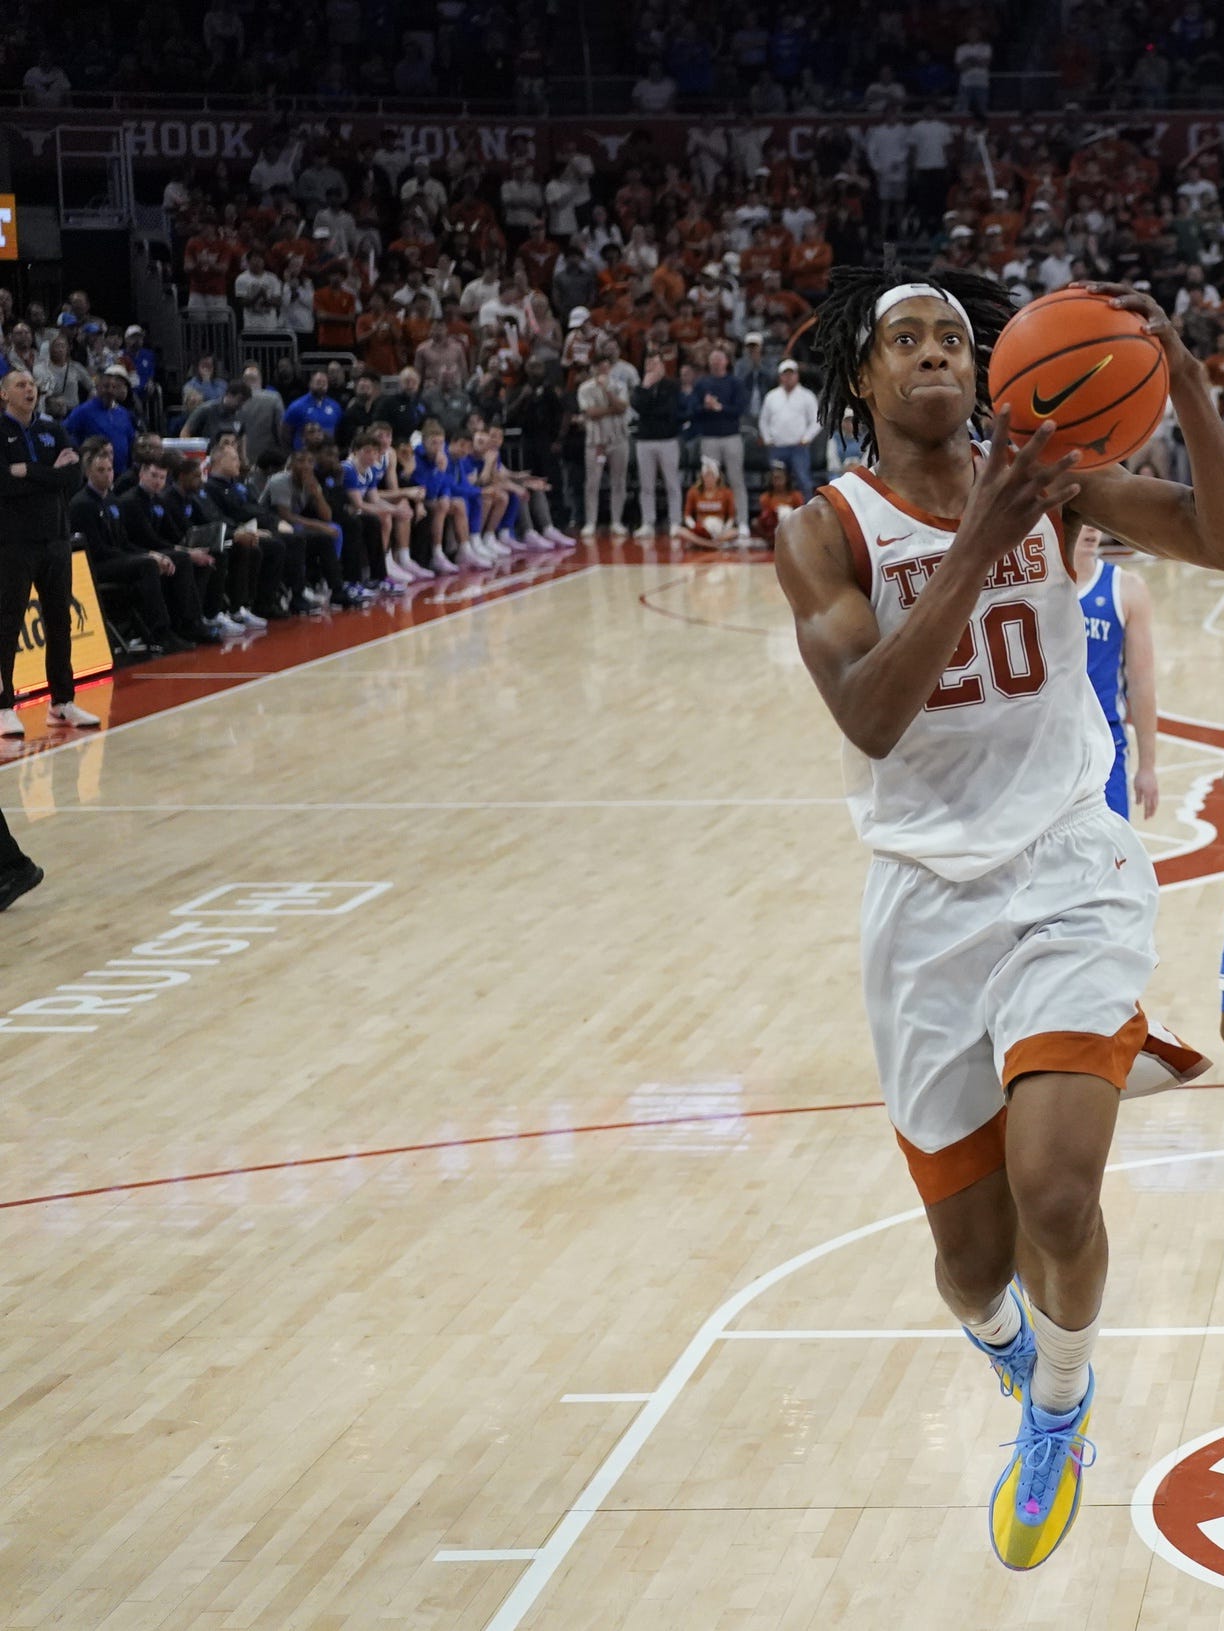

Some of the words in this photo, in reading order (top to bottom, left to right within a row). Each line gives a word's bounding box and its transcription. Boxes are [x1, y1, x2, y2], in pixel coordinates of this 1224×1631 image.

[122, 120, 253, 159] HOOK
[881, 534, 1048, 610] TAS
[924, 599, 1048, 712] 20
